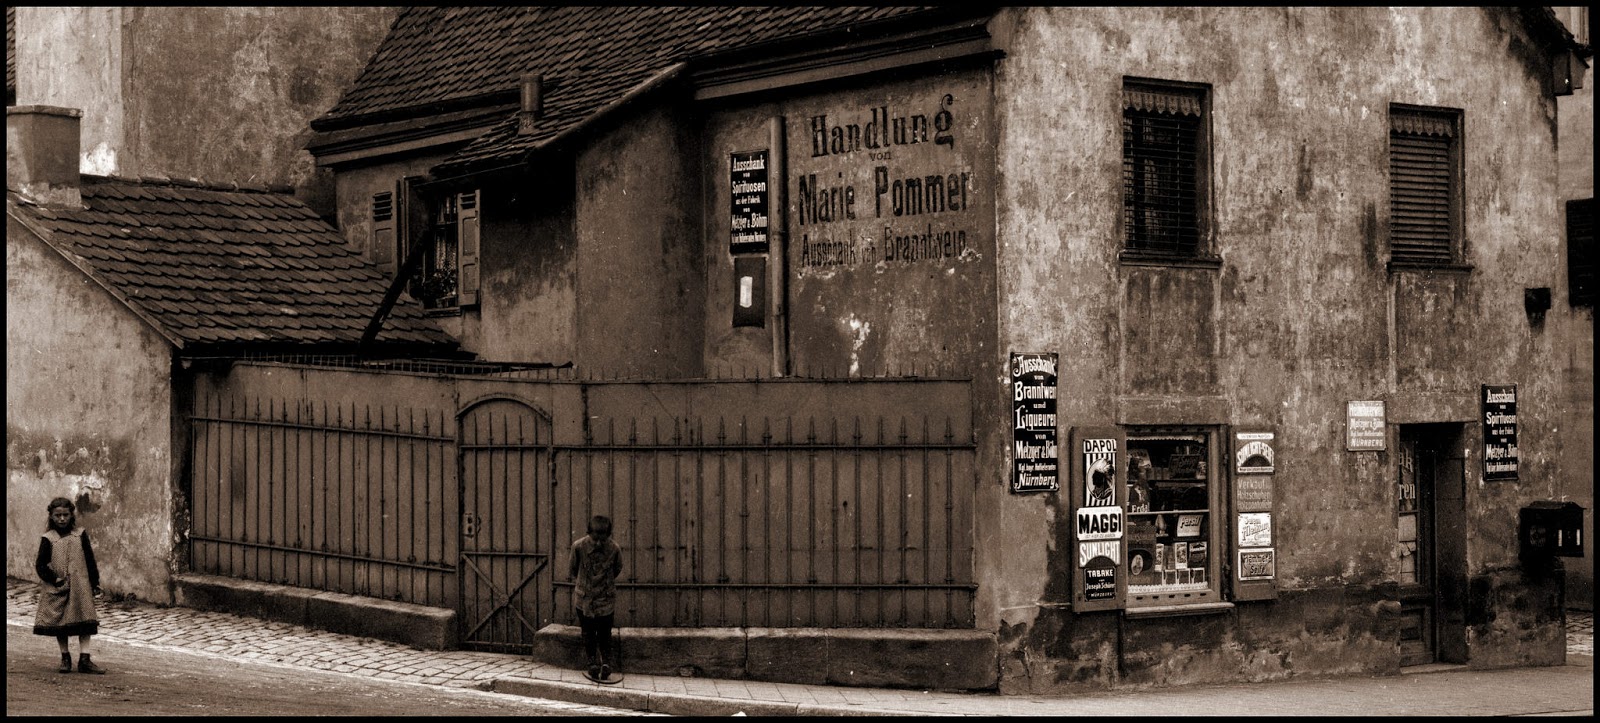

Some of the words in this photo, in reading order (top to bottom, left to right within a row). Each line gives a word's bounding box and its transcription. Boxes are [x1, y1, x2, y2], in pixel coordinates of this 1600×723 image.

[810, 93, 954, 158] Handlung
[732, 154, 765, 172] Ausschank
[868, 151, 892, 162] von
[732, 180, 766, 197] Spirituosen
[874, 166, 970, 219] Pommer
[799, 172, 857, 226] Marie
[884, 223, 967, 263] Branntwein
[1013, 354, 1057, 377] Ausschank
[1014, 381, 1057, 402] Branntwein
[1486, 388, 1516, 403] Ausschank
[1033, 401, 1047, 409] und
[1015, 440, 1042, 462] Metzger
[1085, 440, 1117, 453] DAPOL
[1018, 473, 1056, 489] Nürnberg
[1131, 502, 1150, 513] Erdal
[1078, 513, 1122, 535] MAGGI
[1180, 516, 1201, 529] Persil
[1079, 541, 1121, 567] SUNLIGHT
[1087, 569, 1114, 578] TABAKE
